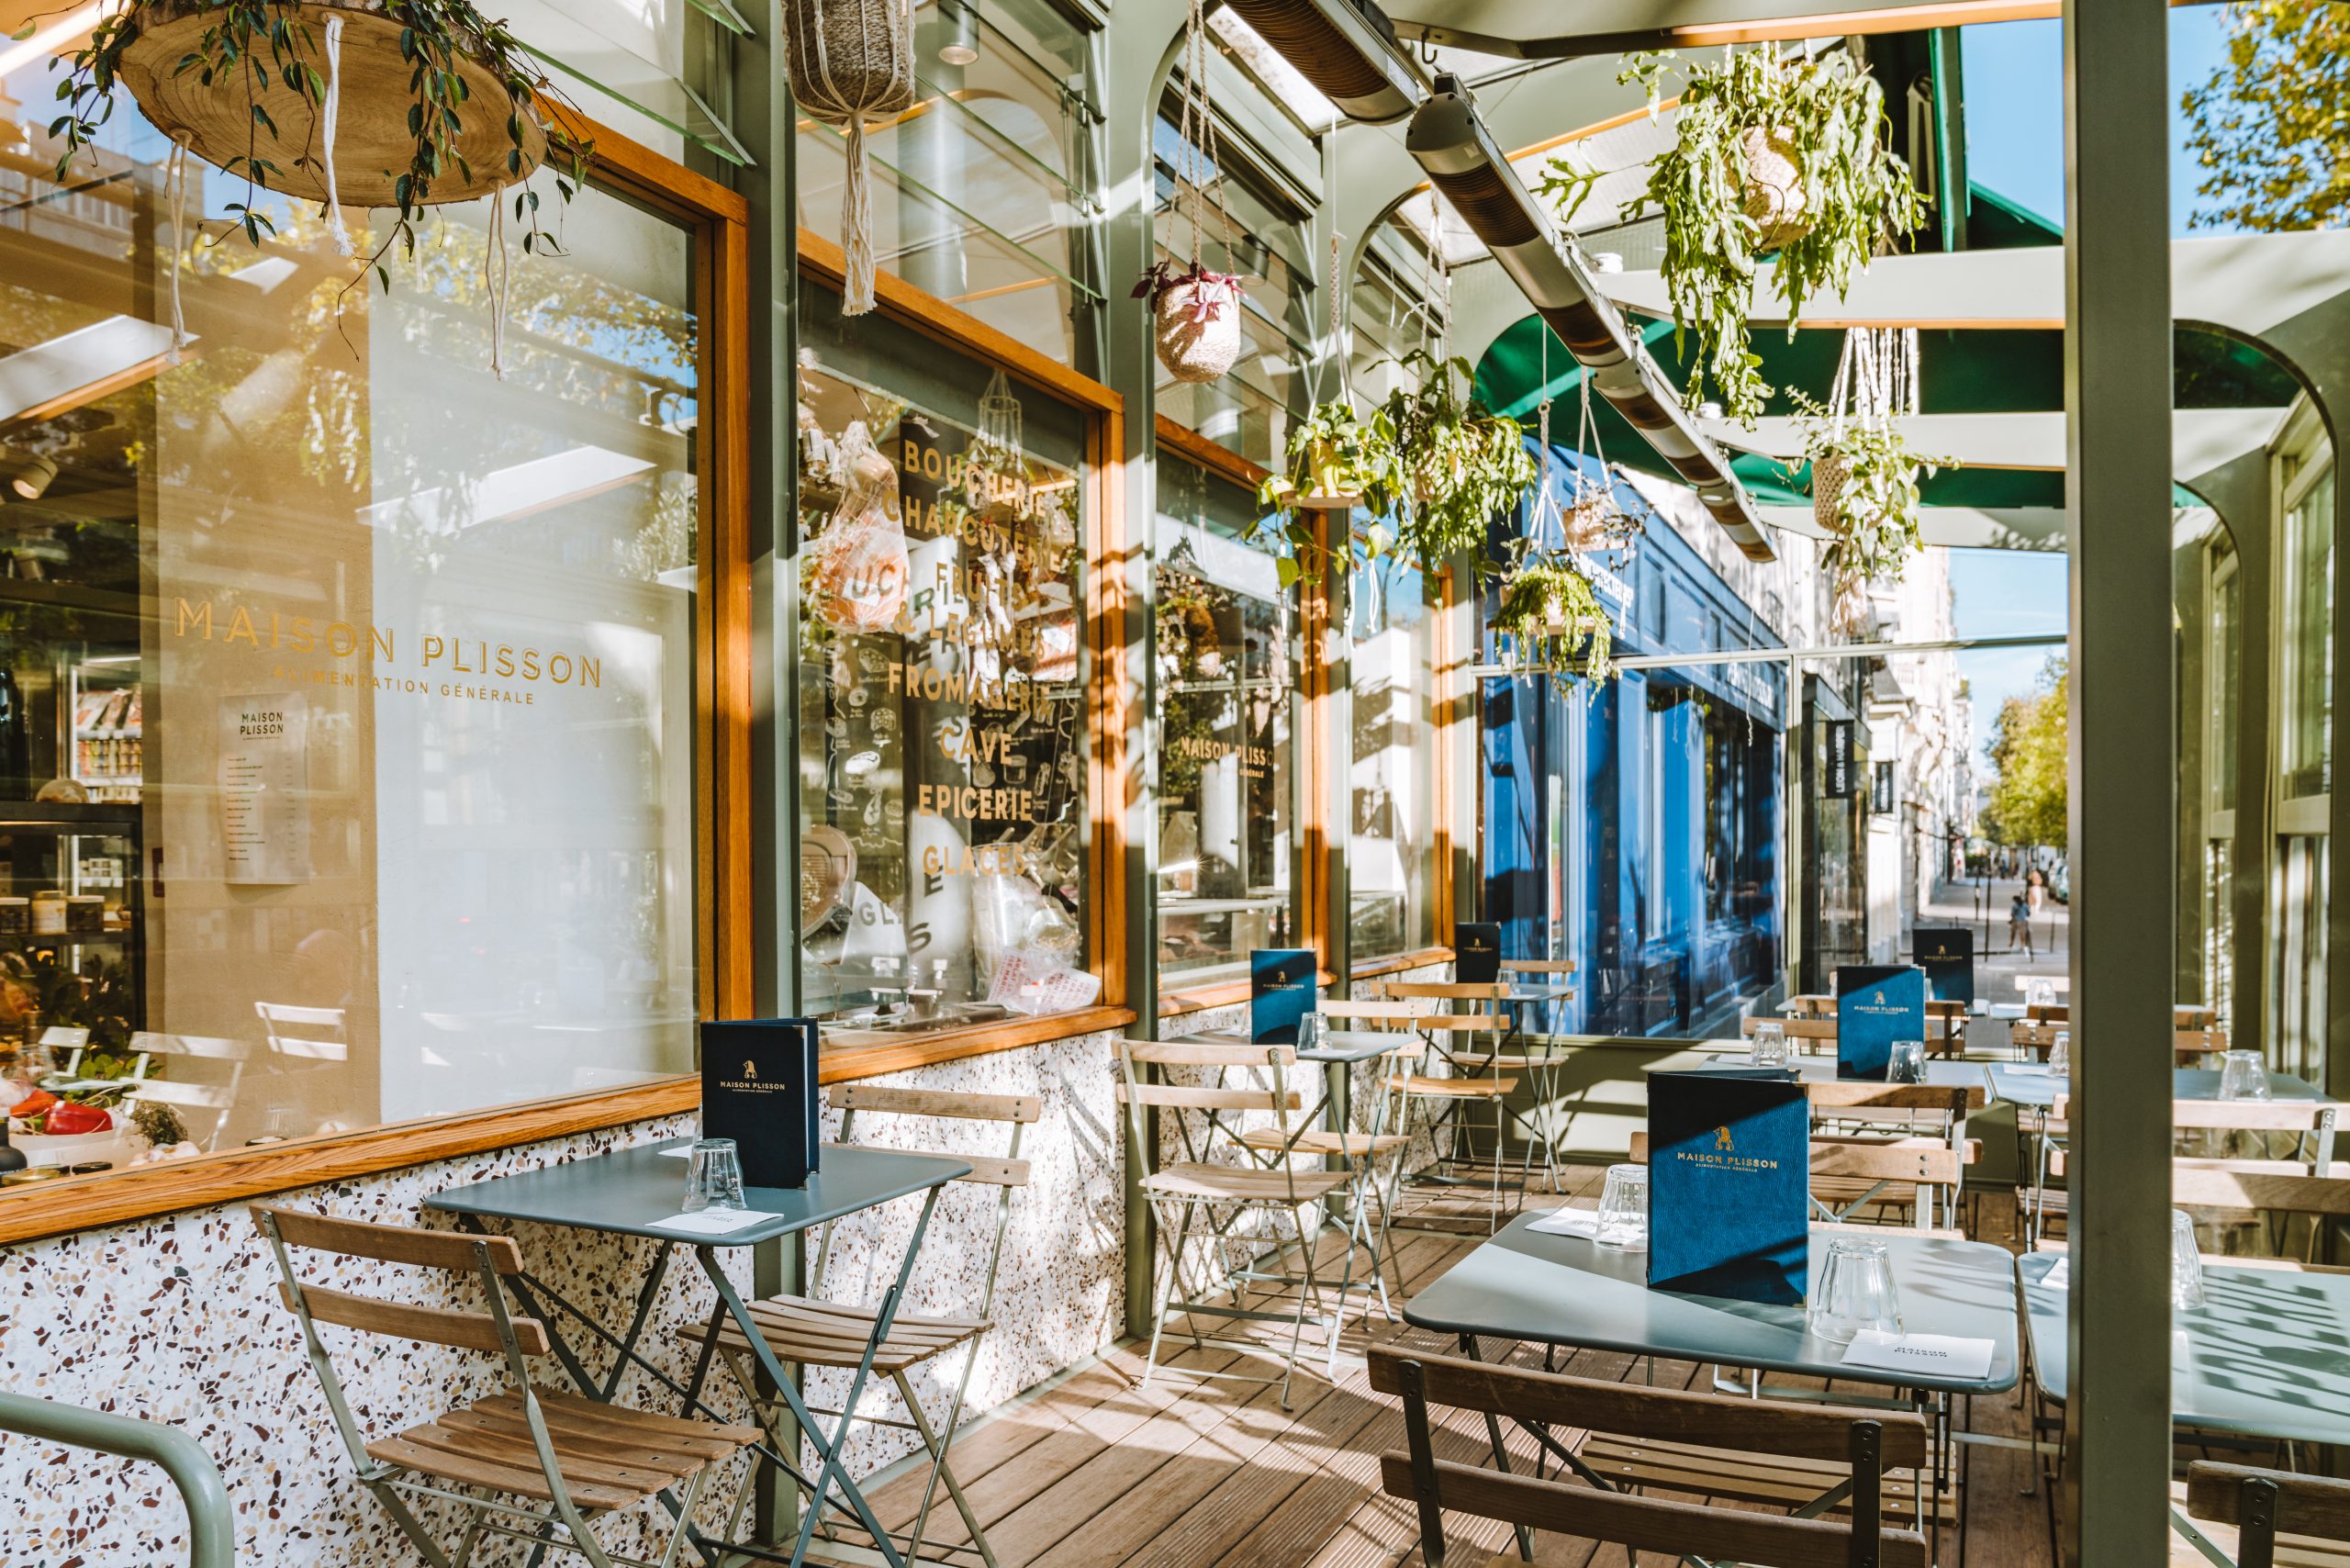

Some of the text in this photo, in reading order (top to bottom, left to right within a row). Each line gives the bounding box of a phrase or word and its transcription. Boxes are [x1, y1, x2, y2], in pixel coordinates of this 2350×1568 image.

[904, 440, 1046, 517] BOUCHERIE
[936, 562, 1028, 611] FRUITS
[174, 597, 601, 688] MAISON PLISSON
[893, 601, 1045, 659] & LEGUMES
[274, 666, 534, 704] ALIMENTATION GÉNÉRALE
[889, 662, 1051, 716] FROMAGERIE
[240, 723, 284, 735] PLISSON
[241, 711, 283, 722] MAISON
[940, 726, 1013, 765] CAVE
[1181, 735, 1273, 767] MAISON PLISSO
[919, 784, 1033, 821] EPICERIE
[923, 845, 1026, 877] GLACES
[1677, 1152, 1778, 1169] MAISON PLISSON
